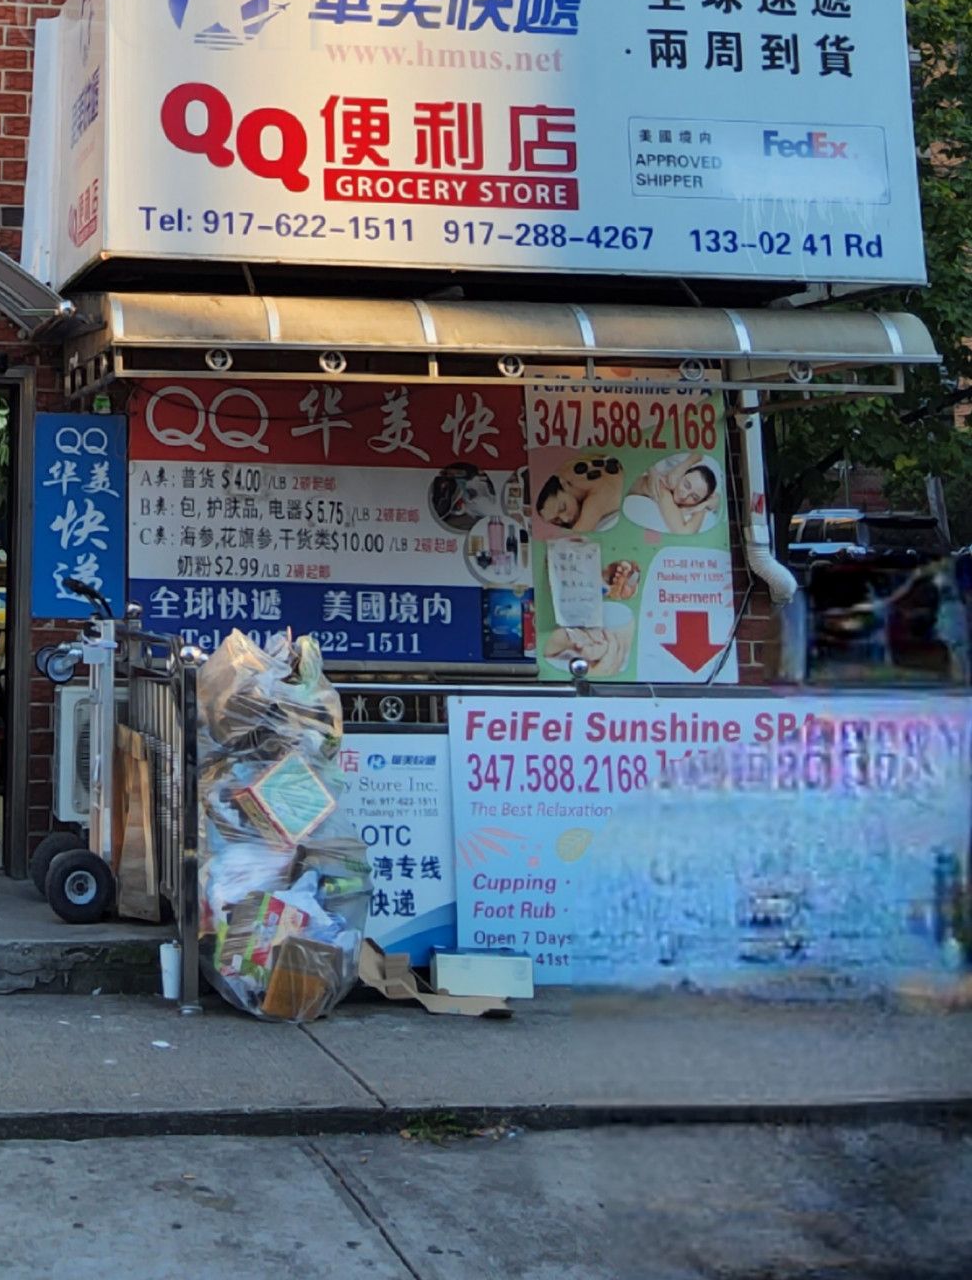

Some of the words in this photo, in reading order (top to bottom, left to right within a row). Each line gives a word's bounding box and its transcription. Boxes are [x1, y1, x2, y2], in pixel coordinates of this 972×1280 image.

[325, 41, 563, 72] www.hmus.net
[647, 28, 856, 78] 兩周到貨
[763, 130, 849, 160] FedEx
[635, 153, 723, 170] APPROVED
[335, 176, 466, 202] GROCERY
[479, 182, 568, 205] STORE
[635, 173, 704, 189] SHIPPER
[139, 207, 192, 233] Tel:
[202, 210, 414, 242] 917-622-1511
[443, 221, 654, 252] 917-288-4267
[802, 233, 833, 257] 41
[844, 233, 884, 258] Rd
[534, 398, 718, 451] 347.588.2168
[56, 427, 108, 456] QQ
[658, 588, 723, 605] Basement
[465, 710, 573, 742] FeiFei
[585, 711, 742, 744] Sunshine
[359, 777, 402, 793] Store
[408, 776, 438, 793] Inc.
[467, 753, 648, 794] 347.588.2168
[470, 801, 497, 817] The
[501, 802, 532, 817] Best
[537, 802, 613, 818] Relaxation
[472, 873, 557, 894] Cupping
[473, 901, 514, 919] Foot
[520, 901, 556, 919] Rub
[473, 931, 516, 951] Open
[522, 932, 530, 945] 7
[535, 931, 573, 951] Days
[535, 953, 570, 967] 41st
